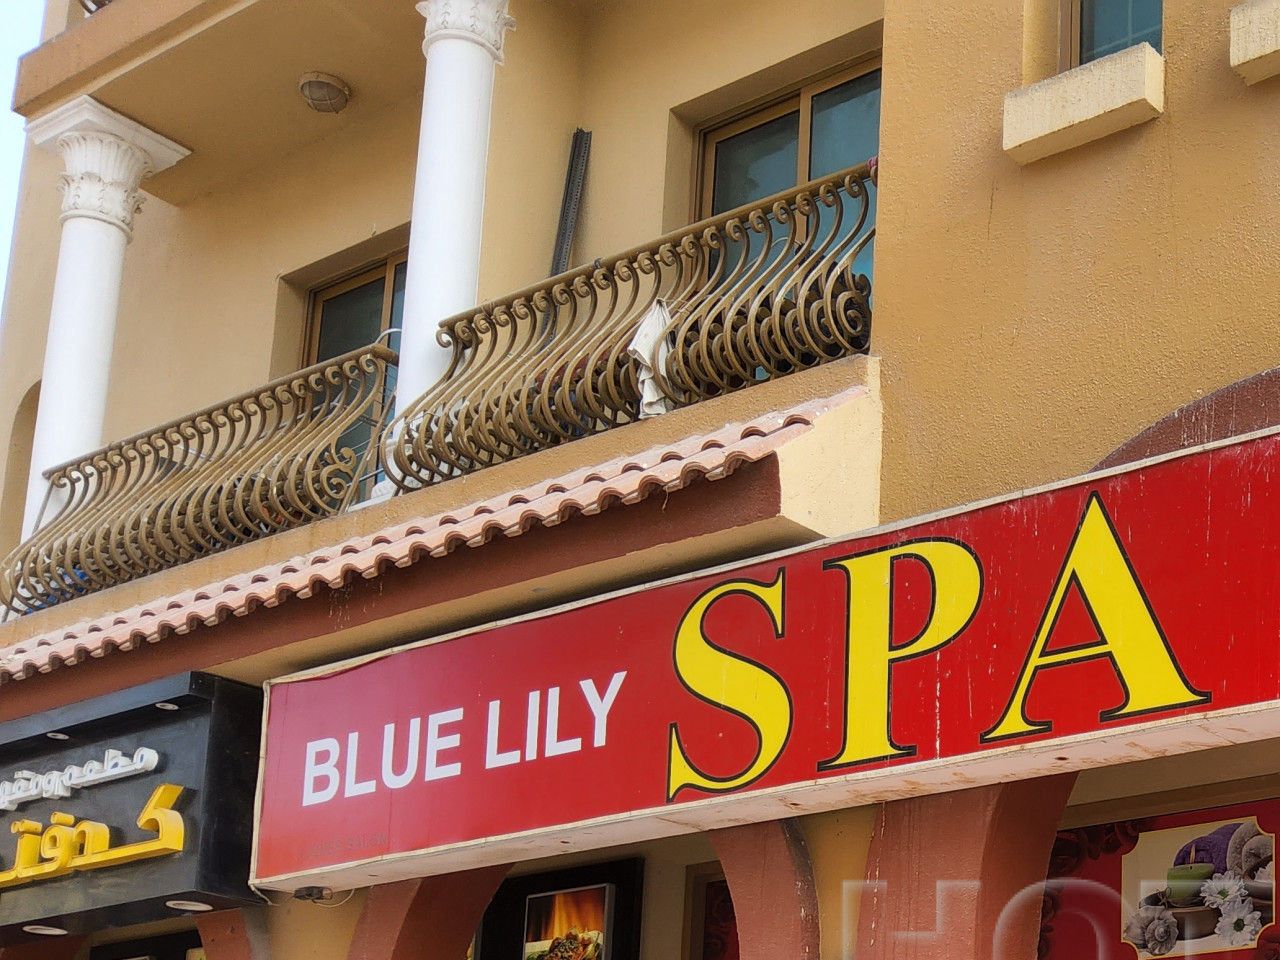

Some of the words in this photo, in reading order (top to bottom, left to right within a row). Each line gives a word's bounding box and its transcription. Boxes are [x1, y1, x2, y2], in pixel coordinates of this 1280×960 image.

[301, 707, 464, 808] BLUE
[485, 671, 627, 769] LILY
[667, 491, 1212, 803] SPA
